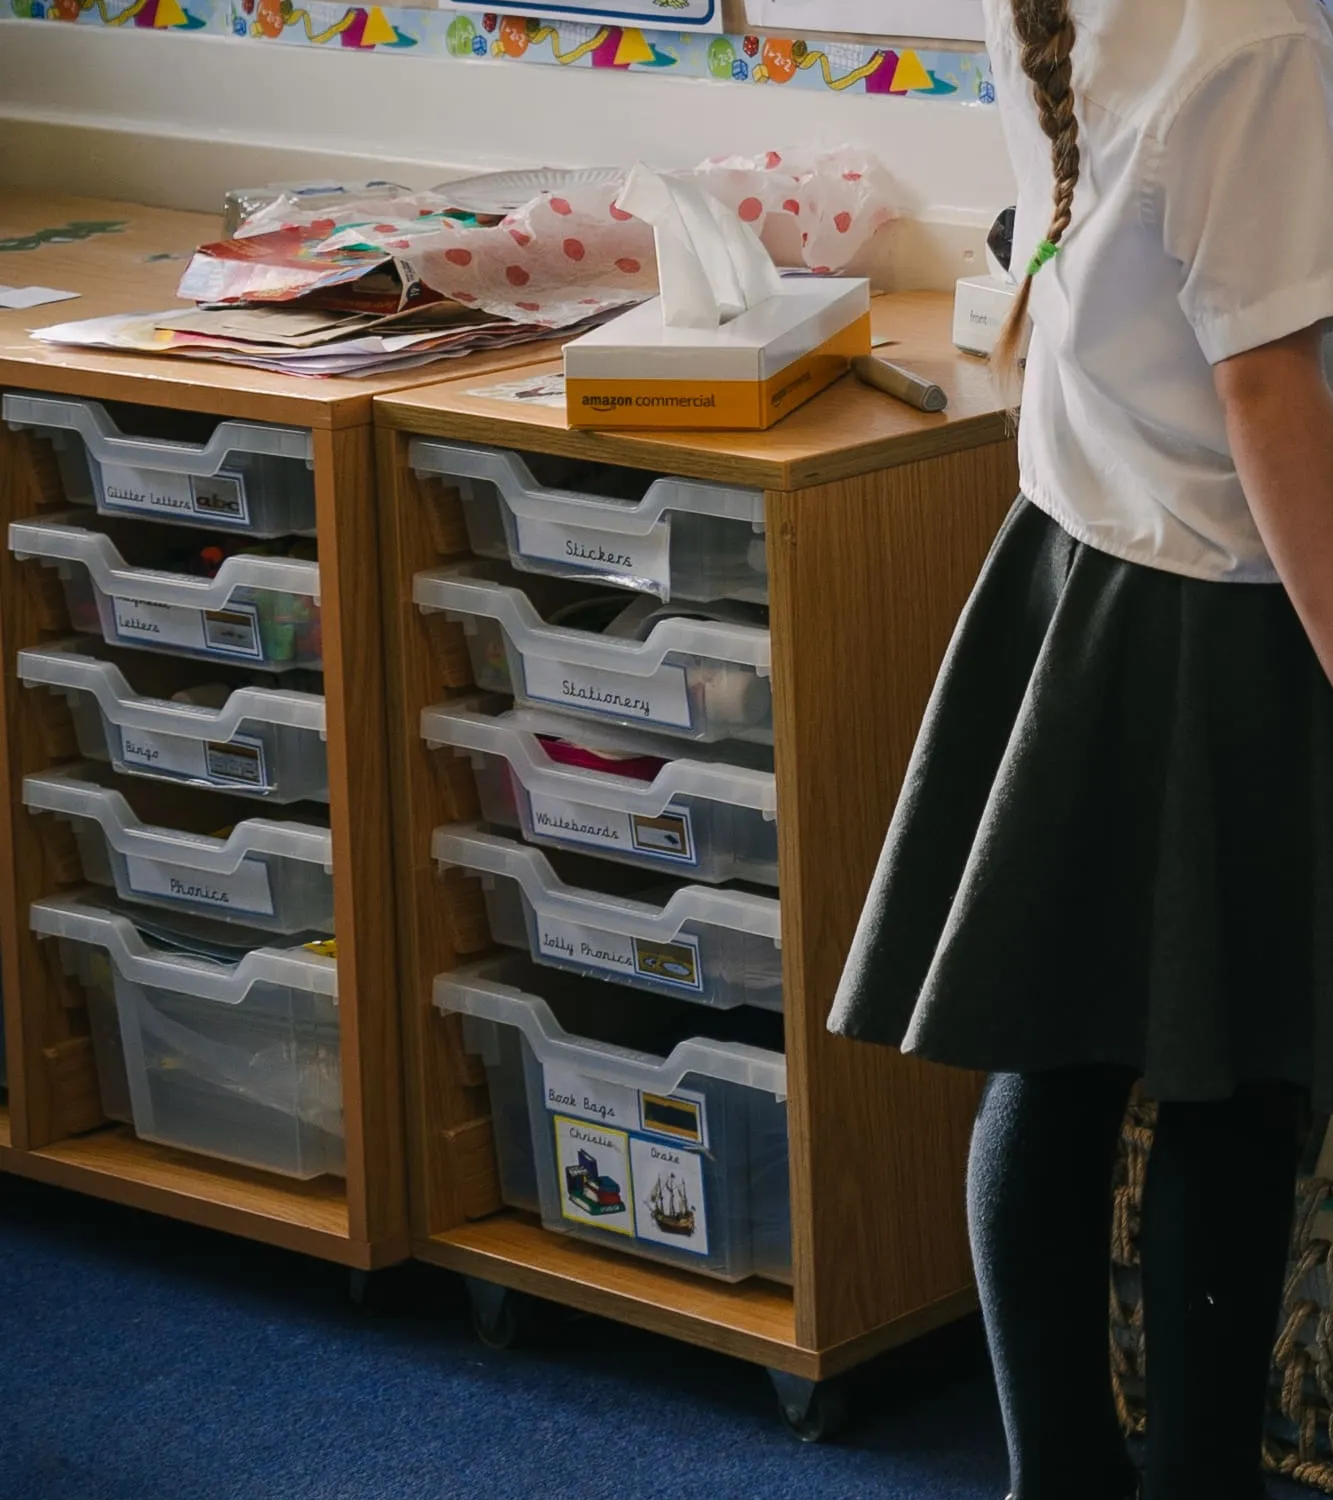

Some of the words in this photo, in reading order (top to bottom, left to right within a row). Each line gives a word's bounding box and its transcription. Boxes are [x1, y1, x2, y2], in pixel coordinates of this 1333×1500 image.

[581, 394, 633, 408] amazon
[635, 394, 716, 408] commercial
[107, 485, 145, 503] Glitter
[150, 492, 191, 510] Letters
[566, 540, 633, 568] Stickers
[119, 614, 160, 633] Letters
[562, 680, 650, 716] Stationery
[126, 740, 159, 761] Bingo
[536, 811, 620, 840] Whiteboards
[170, 878, 230, 903] Phonics
[544, 933, 574, 956] Jolly
[580, 942, 633, 966] Phonics
[548, 1089, 577, 1108] Book
[583, 1098, 617, 1119] Bags
[651, 1147, 680, 1164] Drake
